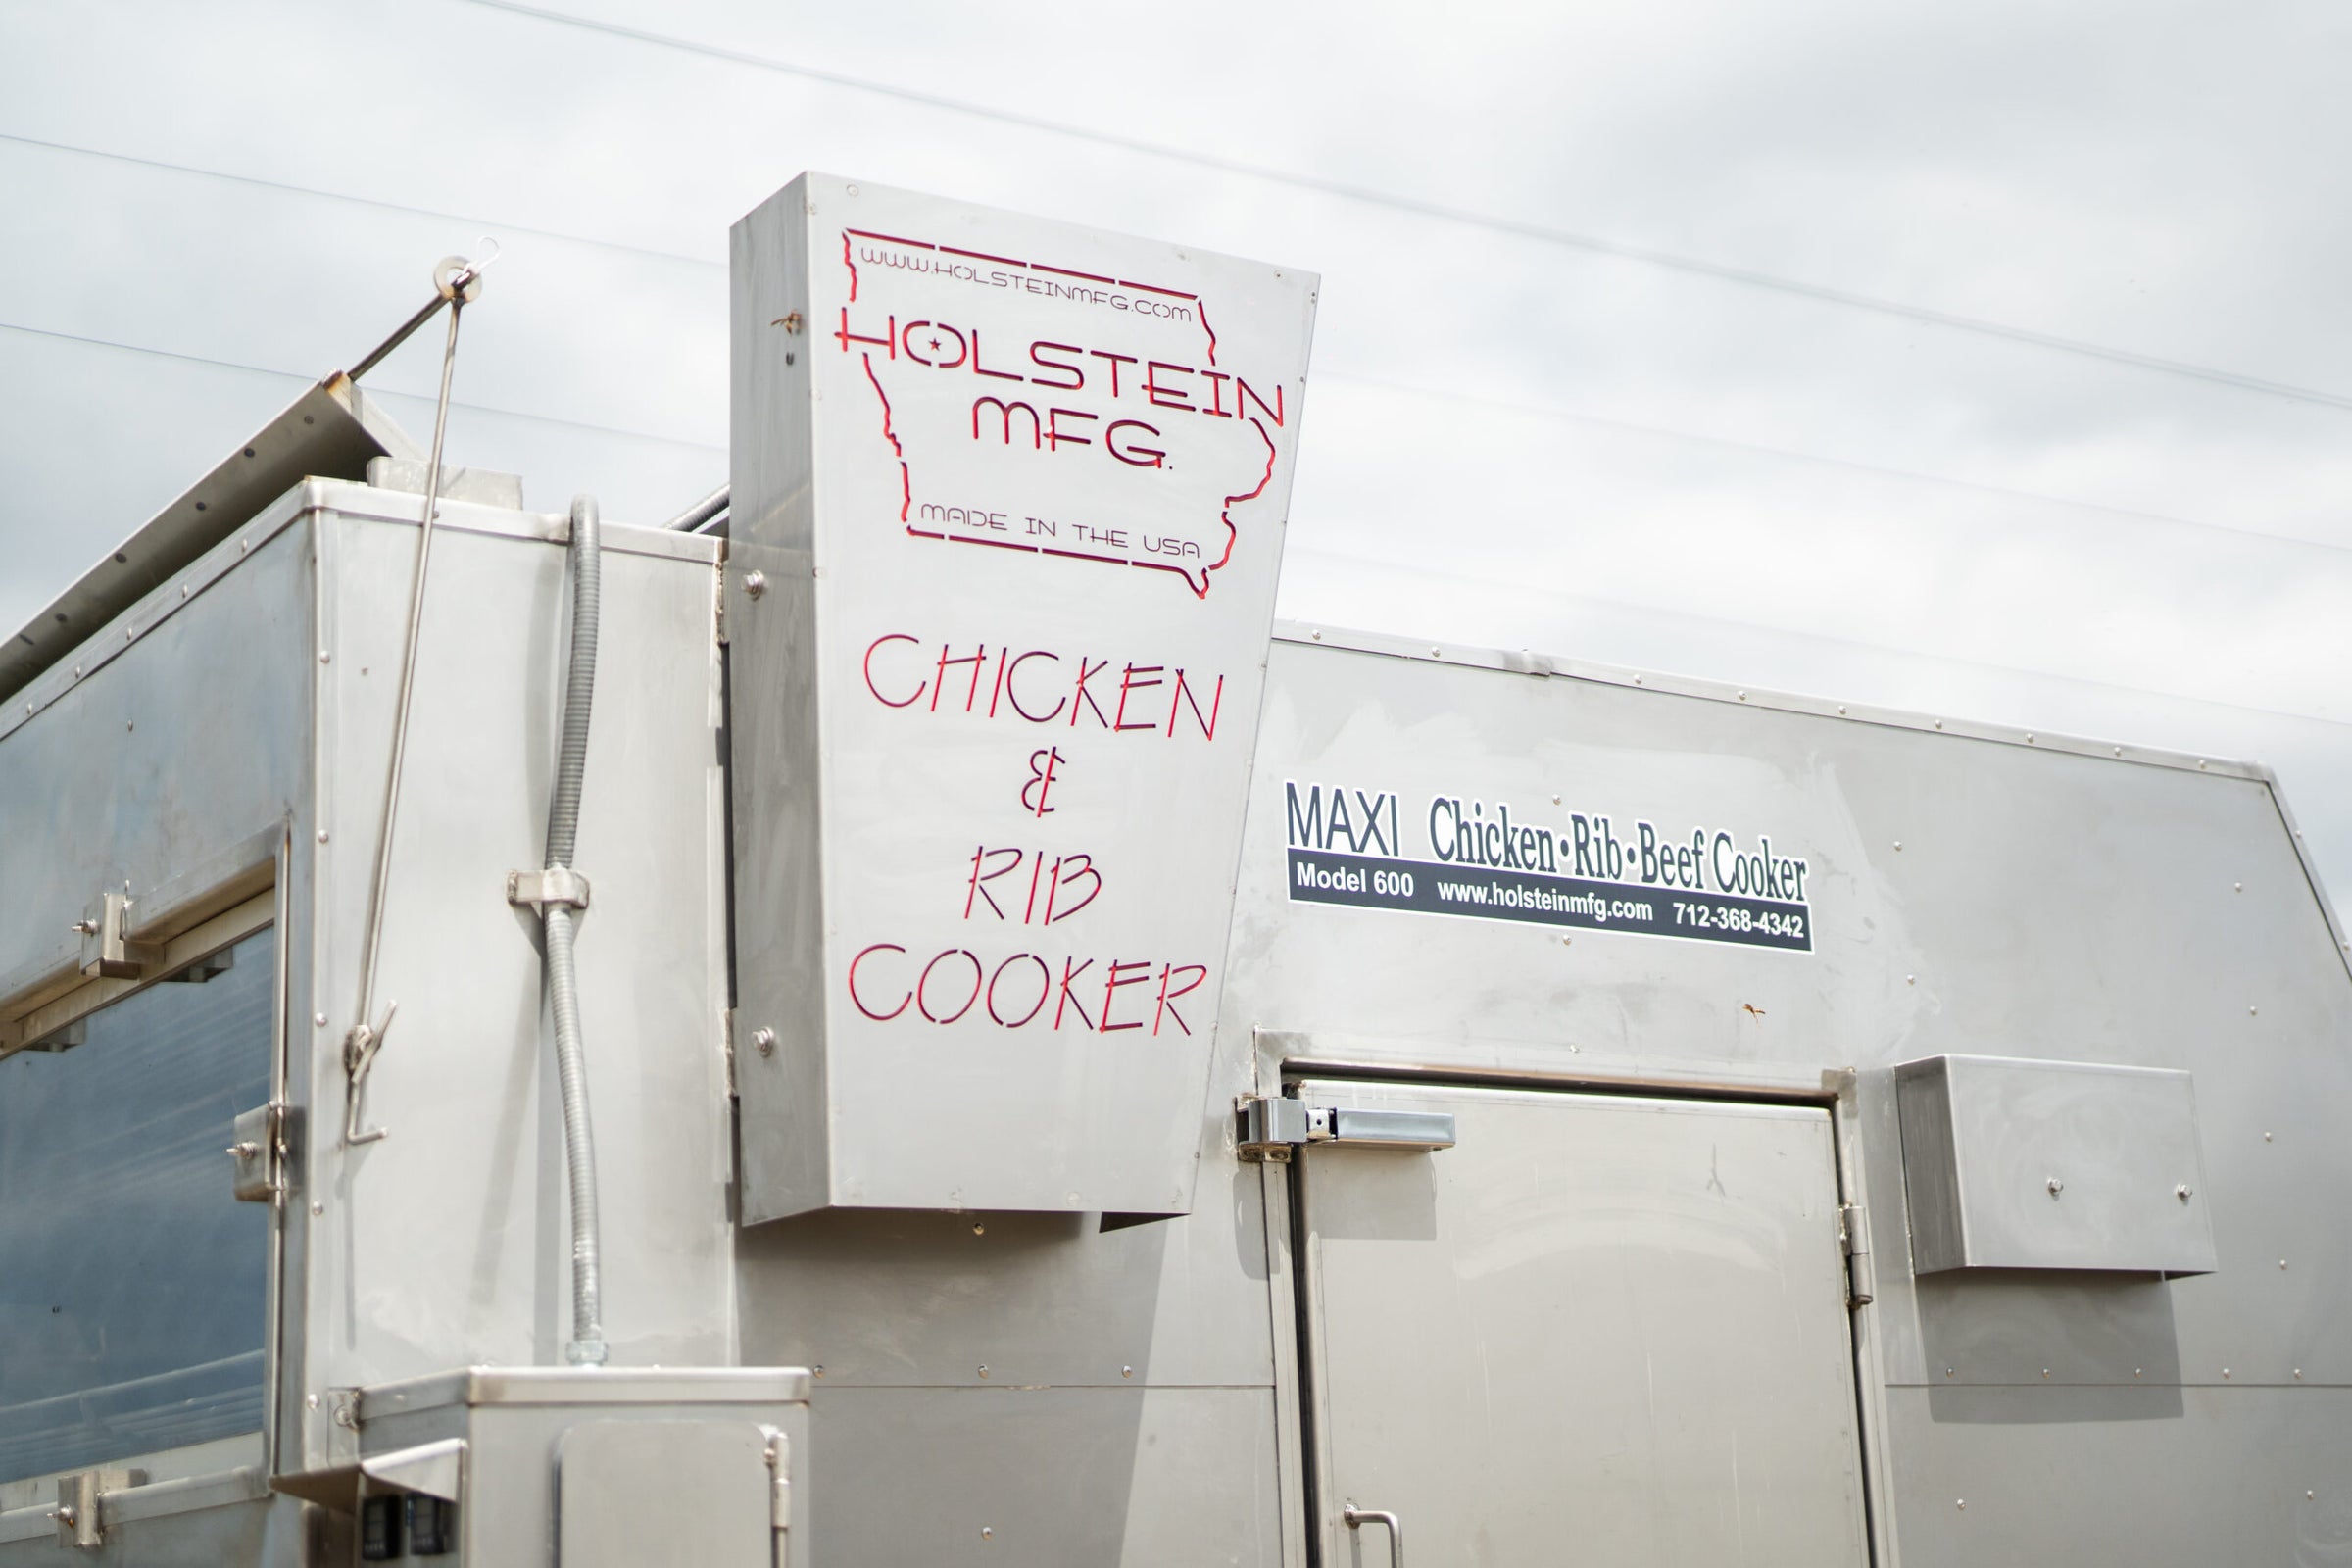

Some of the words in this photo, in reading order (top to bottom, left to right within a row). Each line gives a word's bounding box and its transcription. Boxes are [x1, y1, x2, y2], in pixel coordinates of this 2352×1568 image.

[859, 246, 1193, 324] WWW.HOLSTEINMFG.COM
[834, 307, 1284, 427] HOLSTEIN
[972, 396, 1174, 470] MFG.
[920, 503, 1008, 532] MADE
[1025, 516, 1057, 538] IN
[1071, 522, 1130, 551] THE
[1143, 532, 1200, 560] USA
[864, 633, 1223, 741] CHICKEN
[1021, 746, 1066, 817] &
[1286, 781, 1399, 857] MAXI
[1714, 832, 1806, 902] Cooker
[964, 845, 1102, 926] RIB
[1296, 861, 1367, 894] Model
[1373, 870, 1415, 898] 600
[1437, 881, 1654, 922] www.holsteinmfg.com
[1672, 902, 1805, 939] 712-368-4342
[849, 943, 1207, 1037] COOKER
